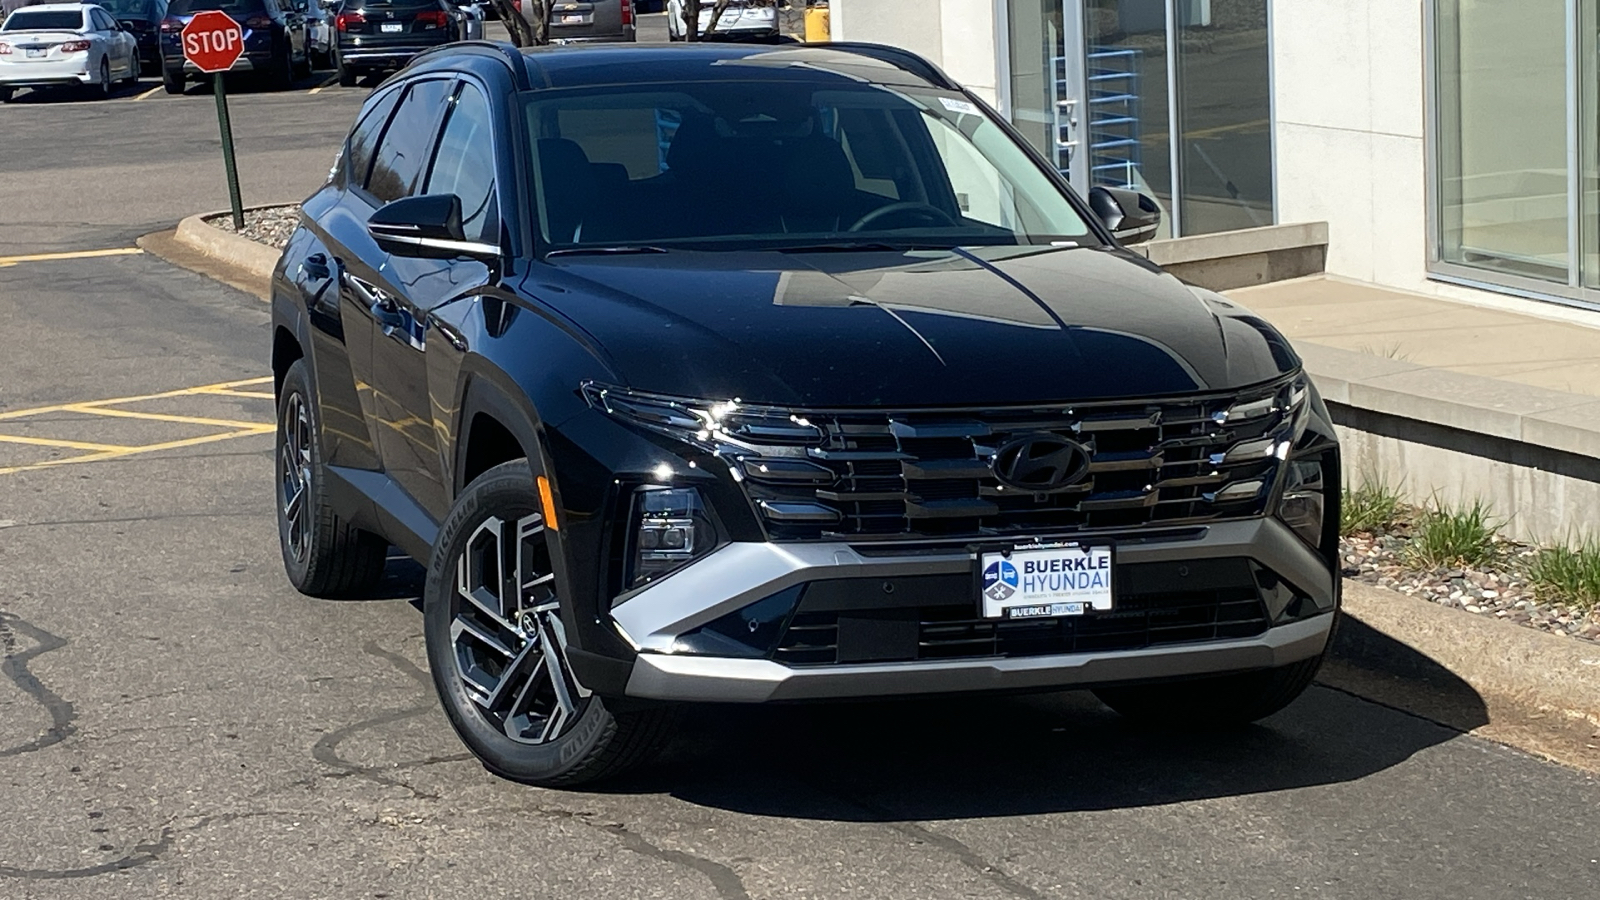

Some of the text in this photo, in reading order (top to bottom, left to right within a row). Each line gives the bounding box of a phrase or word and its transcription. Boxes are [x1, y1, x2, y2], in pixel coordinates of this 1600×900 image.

[187, 28, 239, 55] STOP
[434, 496, 475, 572] MICHELIN
[1024, 556, 1109, 574] BUERKLE
[1024, 571, 1109, 593] HYUNDAI
[1011, 604, 1082, 617] BUERKLE HYUNDAI
[563, 700, 604, 759] ICHELIN
